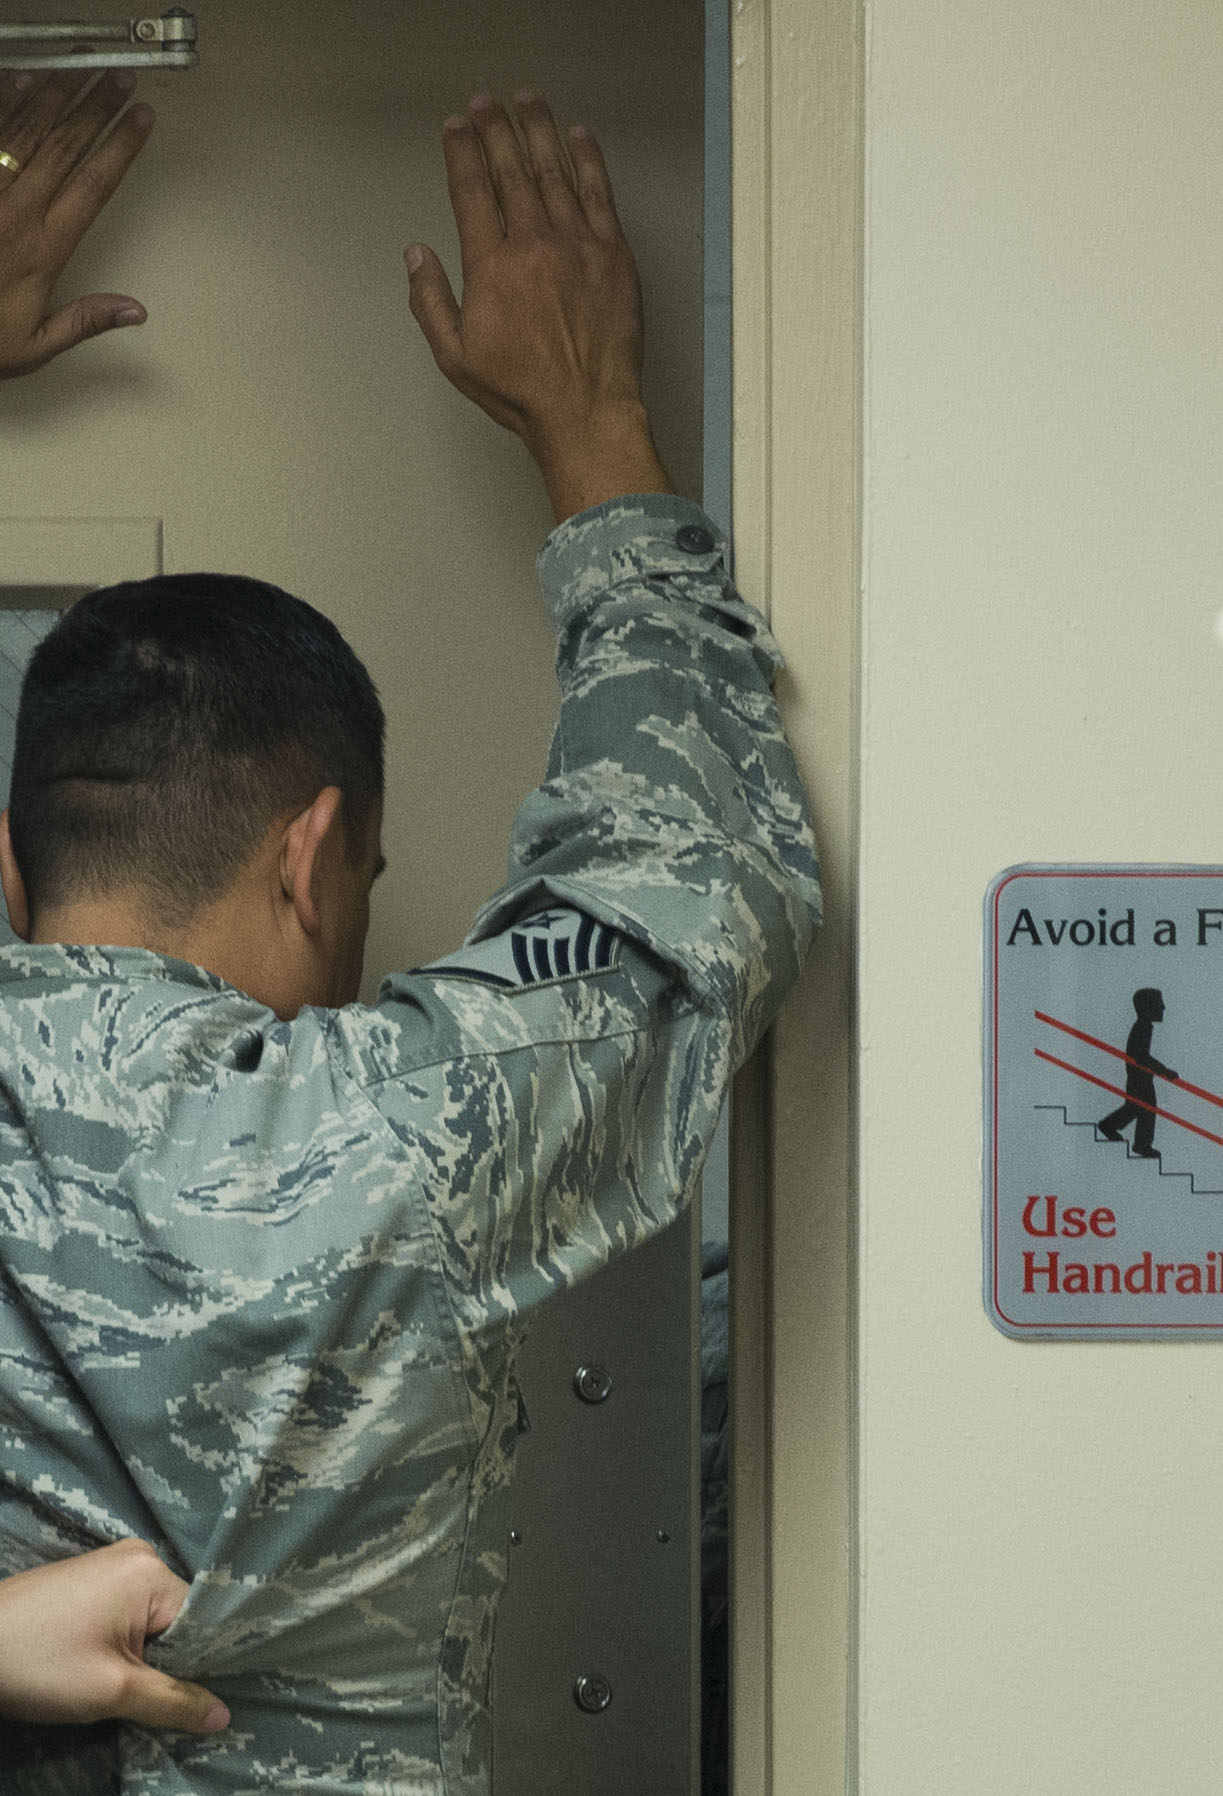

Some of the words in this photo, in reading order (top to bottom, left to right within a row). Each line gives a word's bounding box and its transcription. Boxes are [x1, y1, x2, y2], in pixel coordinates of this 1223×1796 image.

[1006, 908, 1136, 946] Avoid
[1154, 919, 1177, 946] a
[1022, 1195, 1117, 1238] Use
